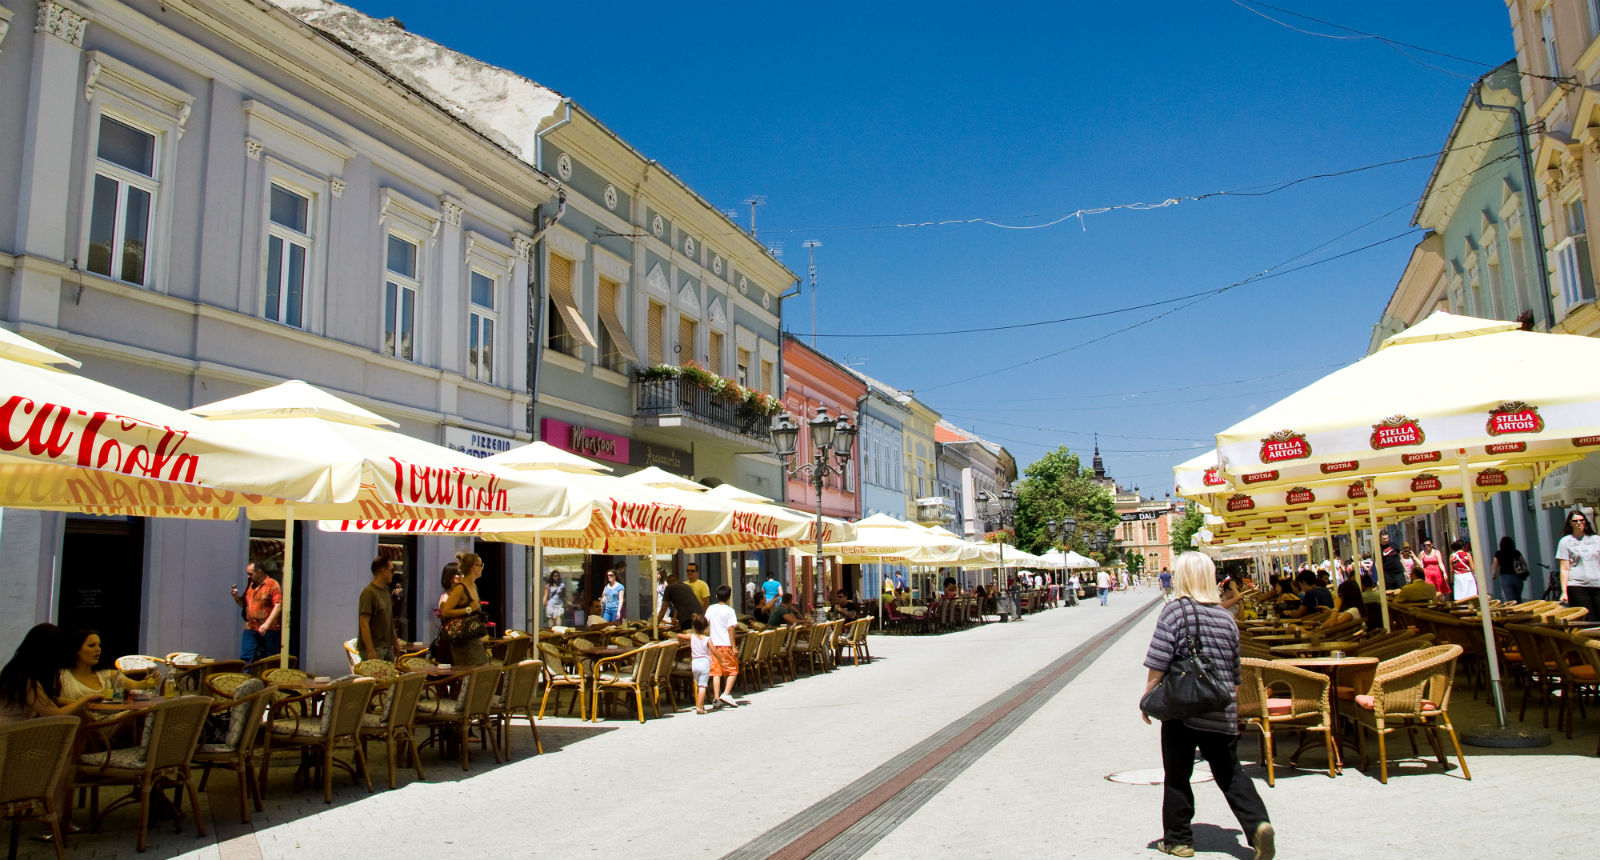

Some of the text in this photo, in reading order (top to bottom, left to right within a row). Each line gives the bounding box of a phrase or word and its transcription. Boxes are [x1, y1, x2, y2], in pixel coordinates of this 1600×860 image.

[1496, 413, 1533, 423] STELLA
[1379, 426, 1414, 437] STELLA
[1497, 421, 1534, 431] ARTOIS
[572, 424, 617, 456] Monsoon
[1380, 434, 1416, 445] ARTOIS
[1268, 440, 1301, 451] STELLA
[1269, 448, 1303, 459] ARTOIS
